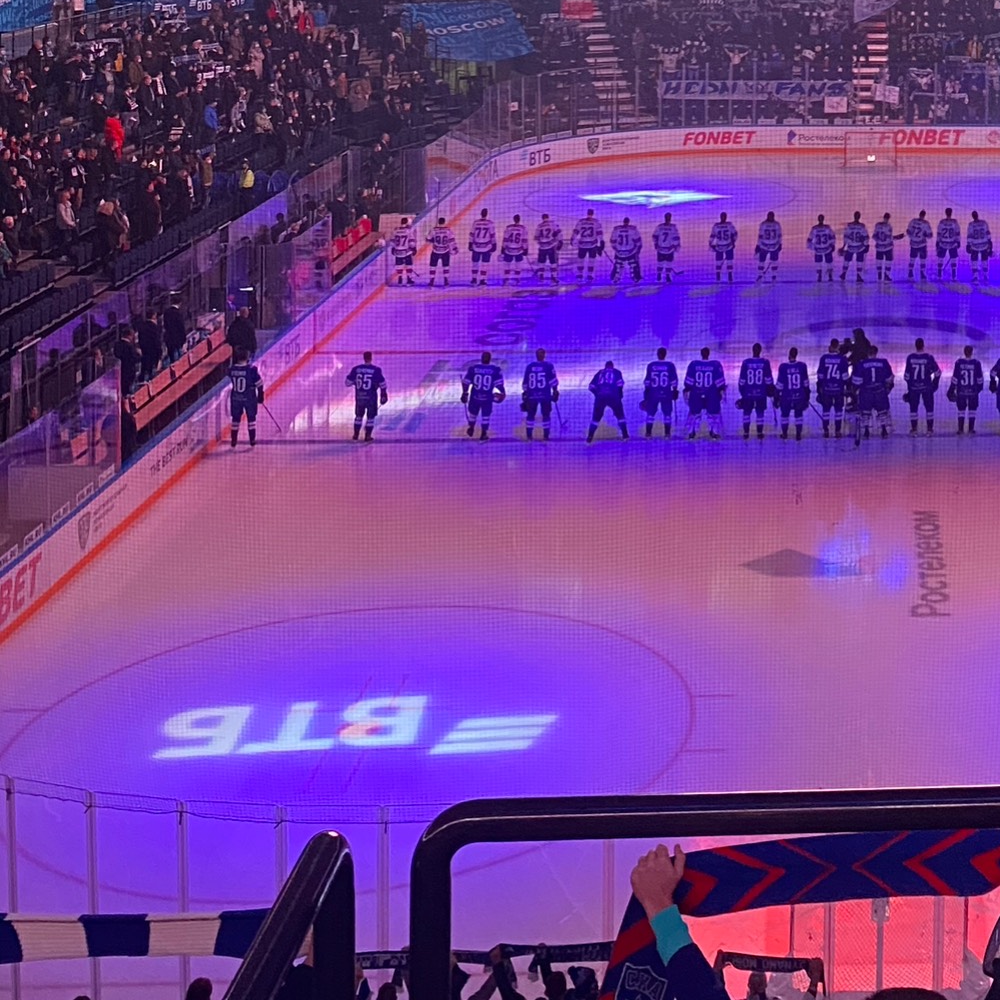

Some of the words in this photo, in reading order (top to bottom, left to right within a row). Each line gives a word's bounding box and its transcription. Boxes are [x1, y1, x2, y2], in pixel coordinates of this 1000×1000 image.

[197, 0, 213, 12] ВТБ
[683, 130, 756, 146] FONBET
[879, 129, 966, 146] FONBET
[529, 148, 552, 166] ВТБ
[475, 227, 490, 239] 77
[580, 226, 594, 238] 23
[528, 372, 546, 388] 85
[650, 371, 668, 387] 56
[695, 371, 713, 387] 90
[746, 369, 763, 385] 88
[825, 364, 841, 380] 74
[870, 368, 876, 382] 1
[911, 365, 925, 379] 71
[960, 370, 975, 385] 31
[232, 376, 247, 393] 10
[355, 373, 372, 390] 65
[473, 374, 492, 391] 99
[787, 373, 801, 389] 19
[910, 509, 951, 618] Ростелеком
[0, 551, 43, 625] BET
